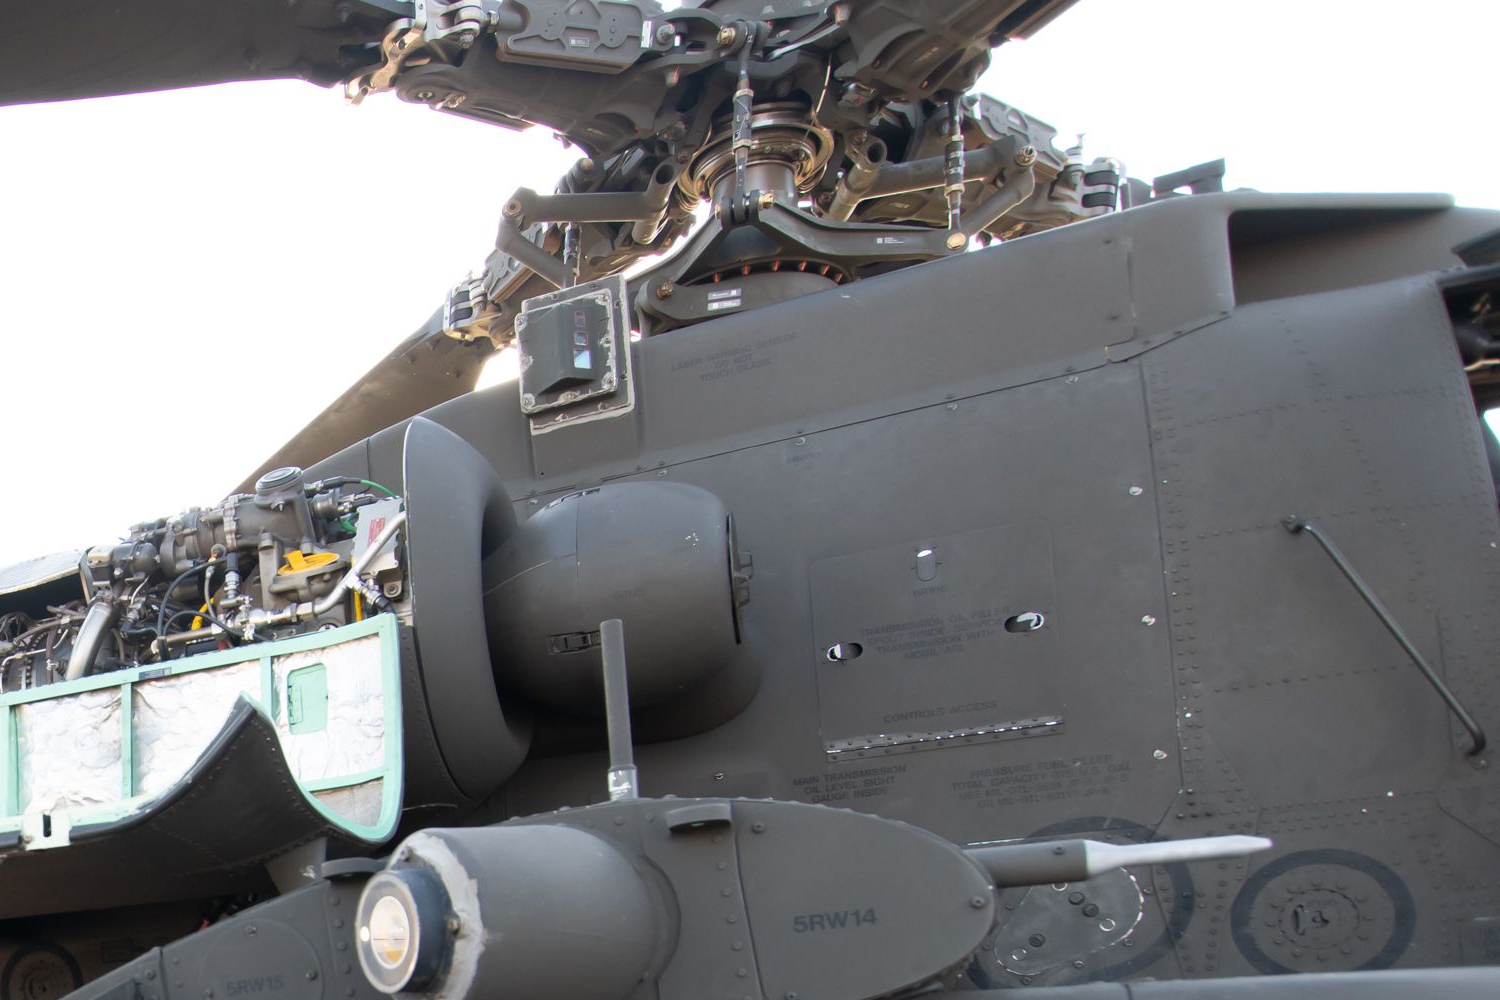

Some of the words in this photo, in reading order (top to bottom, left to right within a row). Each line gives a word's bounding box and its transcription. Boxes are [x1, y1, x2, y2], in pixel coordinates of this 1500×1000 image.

[883, 707, 945, 724] CONTROLS
[949, 699, 998, 714] ACCESS
[792, 775, 819, 786] MAIN
[824, 763, 907, 783] TRANSMISSION
[1037, 759, 1068, 771] FUEL
[804, 786, 822, 795] OIL
[825, 781, 859, 793] LEVEL
[863, 775, 896, 788] SIGHT
[951, 780, 983, 792] TOTAL
[990, 773, 1048, 787] CAPACITY
[811, 791, 850, 803] GAUGE
[854, 786, 891, 798] INSIDE
[793, 907, 879, 934] 5RW14
[227, 975, 285, 996] 5RW15
